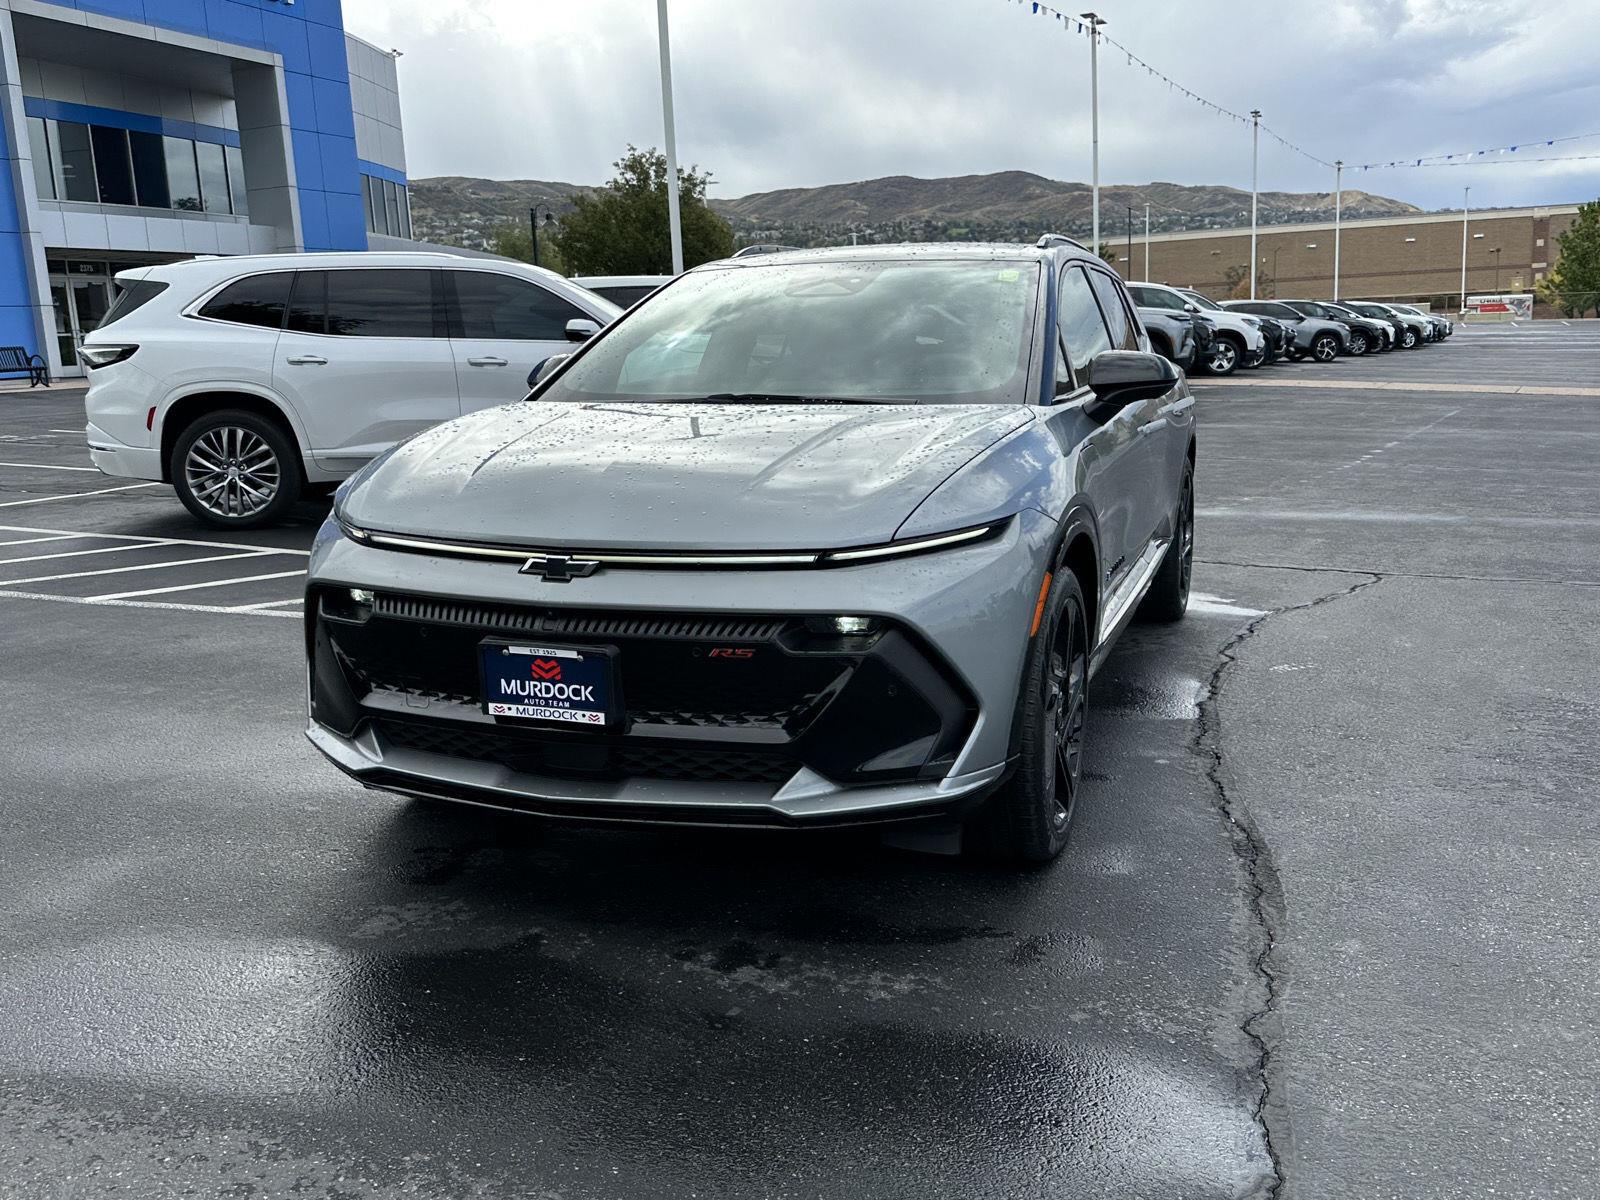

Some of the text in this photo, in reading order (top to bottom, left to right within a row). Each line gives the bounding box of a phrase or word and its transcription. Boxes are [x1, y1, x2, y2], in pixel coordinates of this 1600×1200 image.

[501, 678, 594, 701] MURDOCK
[524, 698, 545, 706] AUTO
[516, 706, 578, 720] MURDOCK
